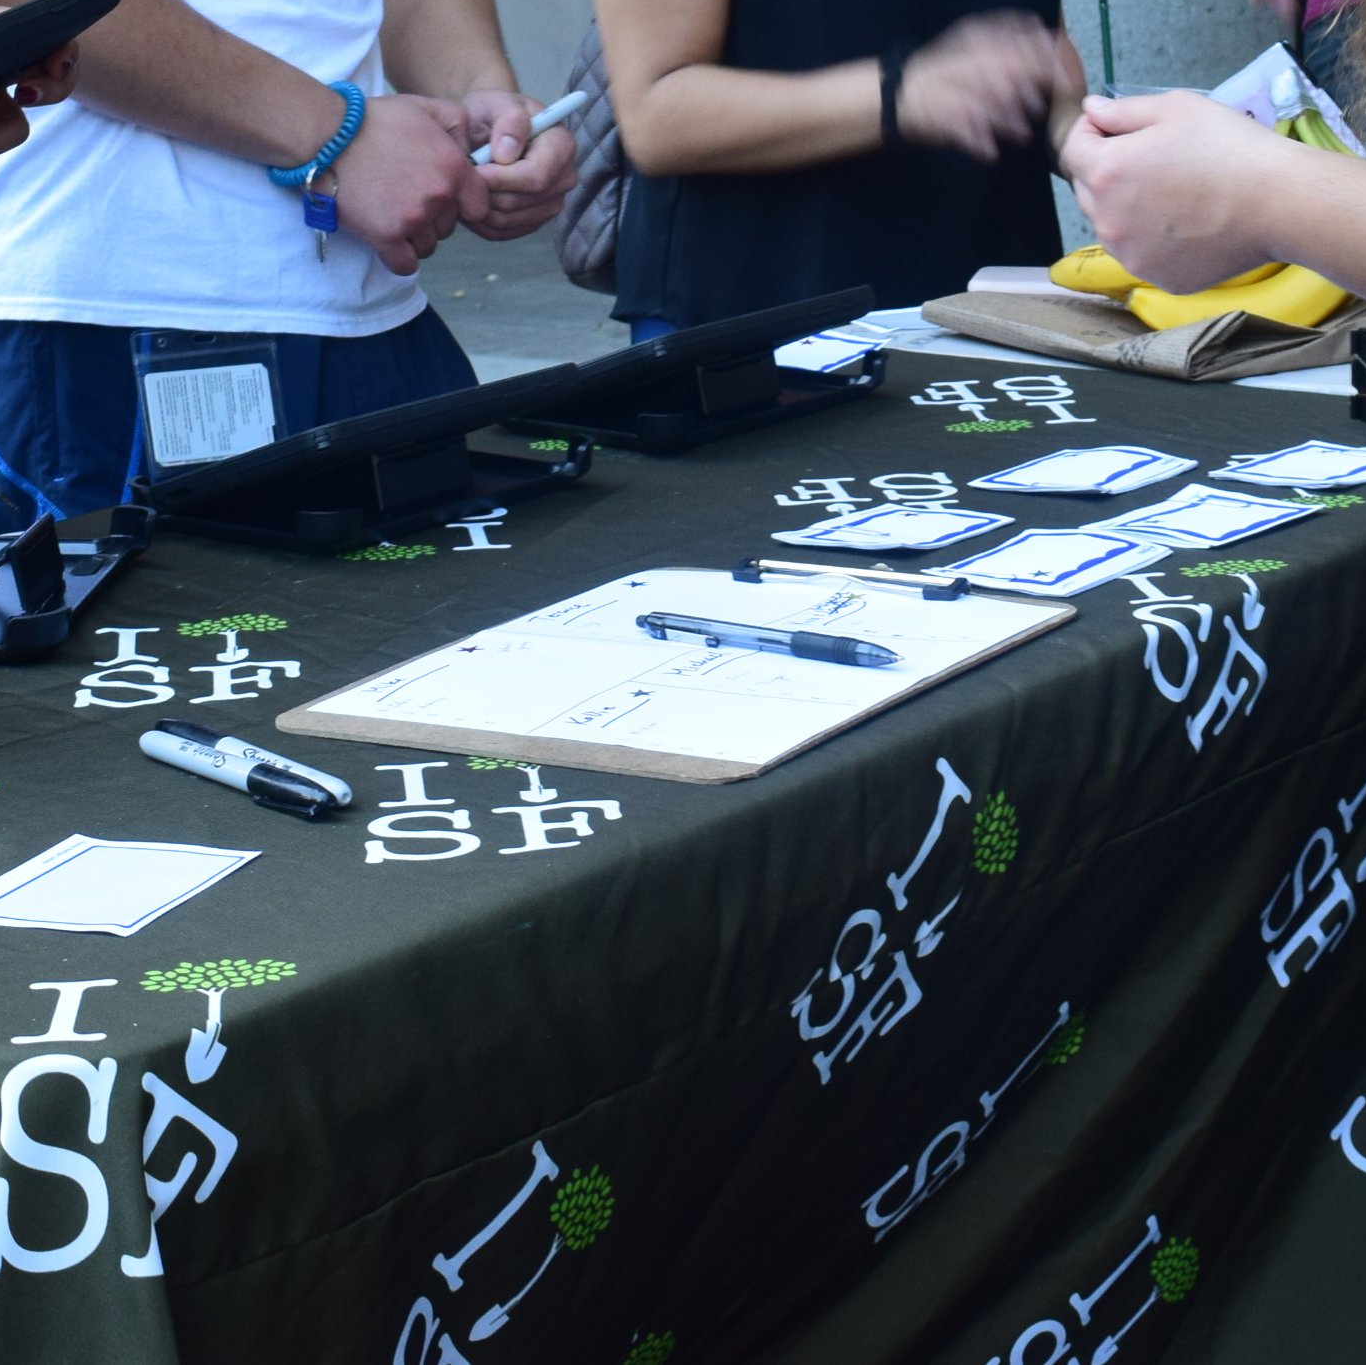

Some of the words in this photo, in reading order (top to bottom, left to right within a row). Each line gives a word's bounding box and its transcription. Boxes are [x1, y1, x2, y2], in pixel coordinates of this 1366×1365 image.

[93, 627, 160, 666] I
[73, 660, 301, 708] SF
[374, 761, 455, 808] I
[364, 799, 623, 864] SF
[886, 757, 972, 912] I
[10, 978, 118, 1044] I
[432, 1140, 560, 1292] I
[1069, 1214, 1162, 1326] I
